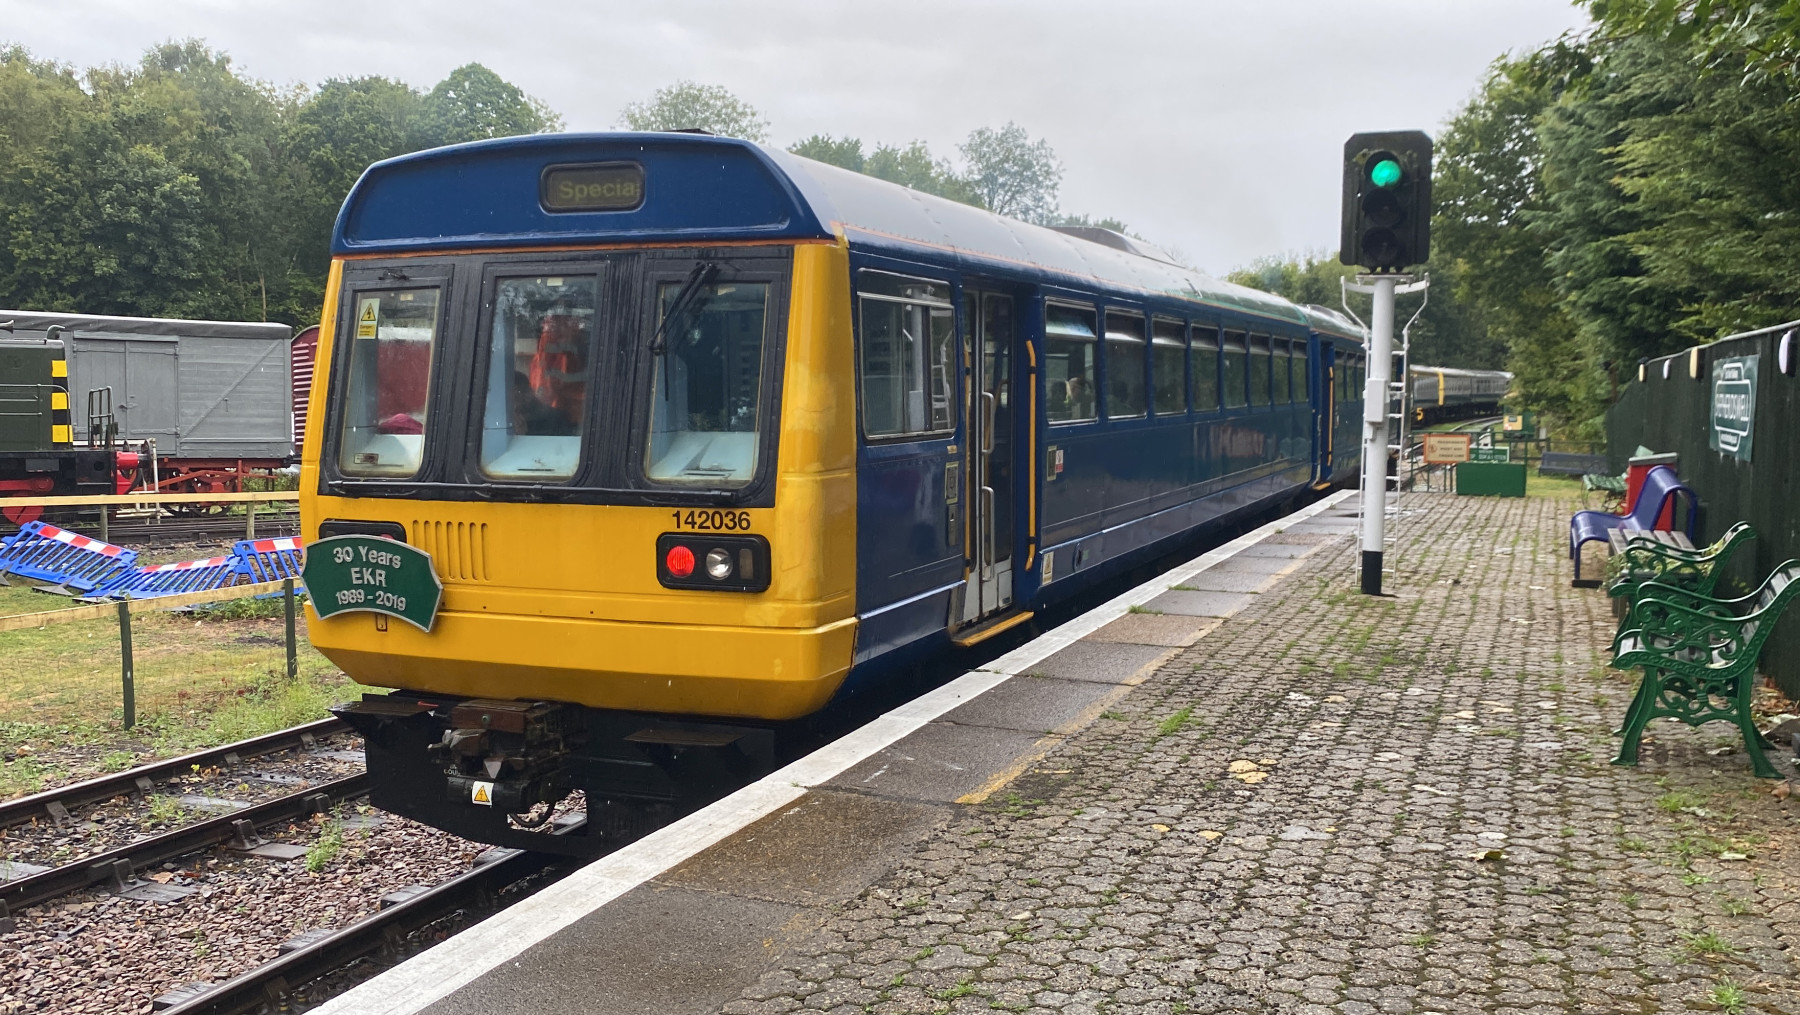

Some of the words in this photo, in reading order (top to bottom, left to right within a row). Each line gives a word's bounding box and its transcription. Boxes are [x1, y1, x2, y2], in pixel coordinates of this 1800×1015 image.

[560, 180, 640, 202] Specia
[672, 510, 751, 530] 142036
[333, 546, 354, 564] 30
[358, 546, 401, 569] Years
[351, 567, 387, 587] EKR
[335, 589, 365, 605] 1989
[375, 590, 406, 611] 2019
